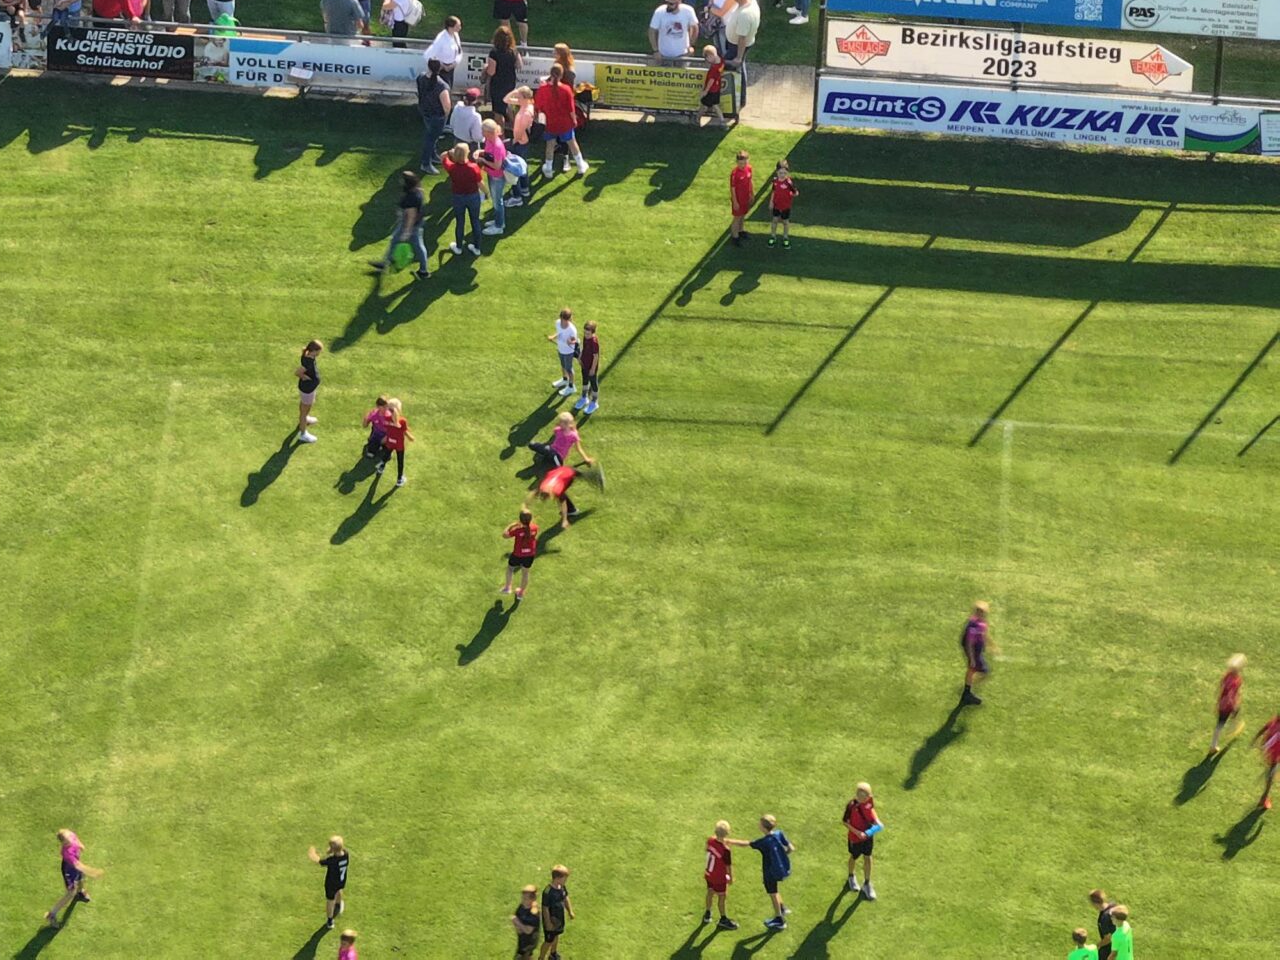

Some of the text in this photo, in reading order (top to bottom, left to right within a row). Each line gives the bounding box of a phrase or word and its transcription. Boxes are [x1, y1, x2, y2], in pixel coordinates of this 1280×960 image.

[999, 0, 1039, 9] COMPANY
[1128, 7, 1156, 18] PAS
[86, 30, 154, 45] MEPPENS
[901, 26, 1122, 63] Bezirksligaaufstieg
[842, 41, 886, 54] EMSLAGE
[76, 54, 164, 71] Schützenhof
[236, 56, 297, 70] VOLLER
[302, 61, 371, 76] ENERGIE
[982, 57, 1038, 78] 2023
[1136, 62, 1169, 74] EMSLA
[236, 69, 267, 83] FÜR
[605, 65, 704, 81] 1a autoservice
[606, 75, 704, 90] Norbert Heidemann
[1121, 102, 1182, 114] www.kuzka.de
[1006, 104, 1124, 134] KUZKA
[947, 124, 1181, 148] MEPPEN HASELÜNNE LINGEN GÜTERSLOH
